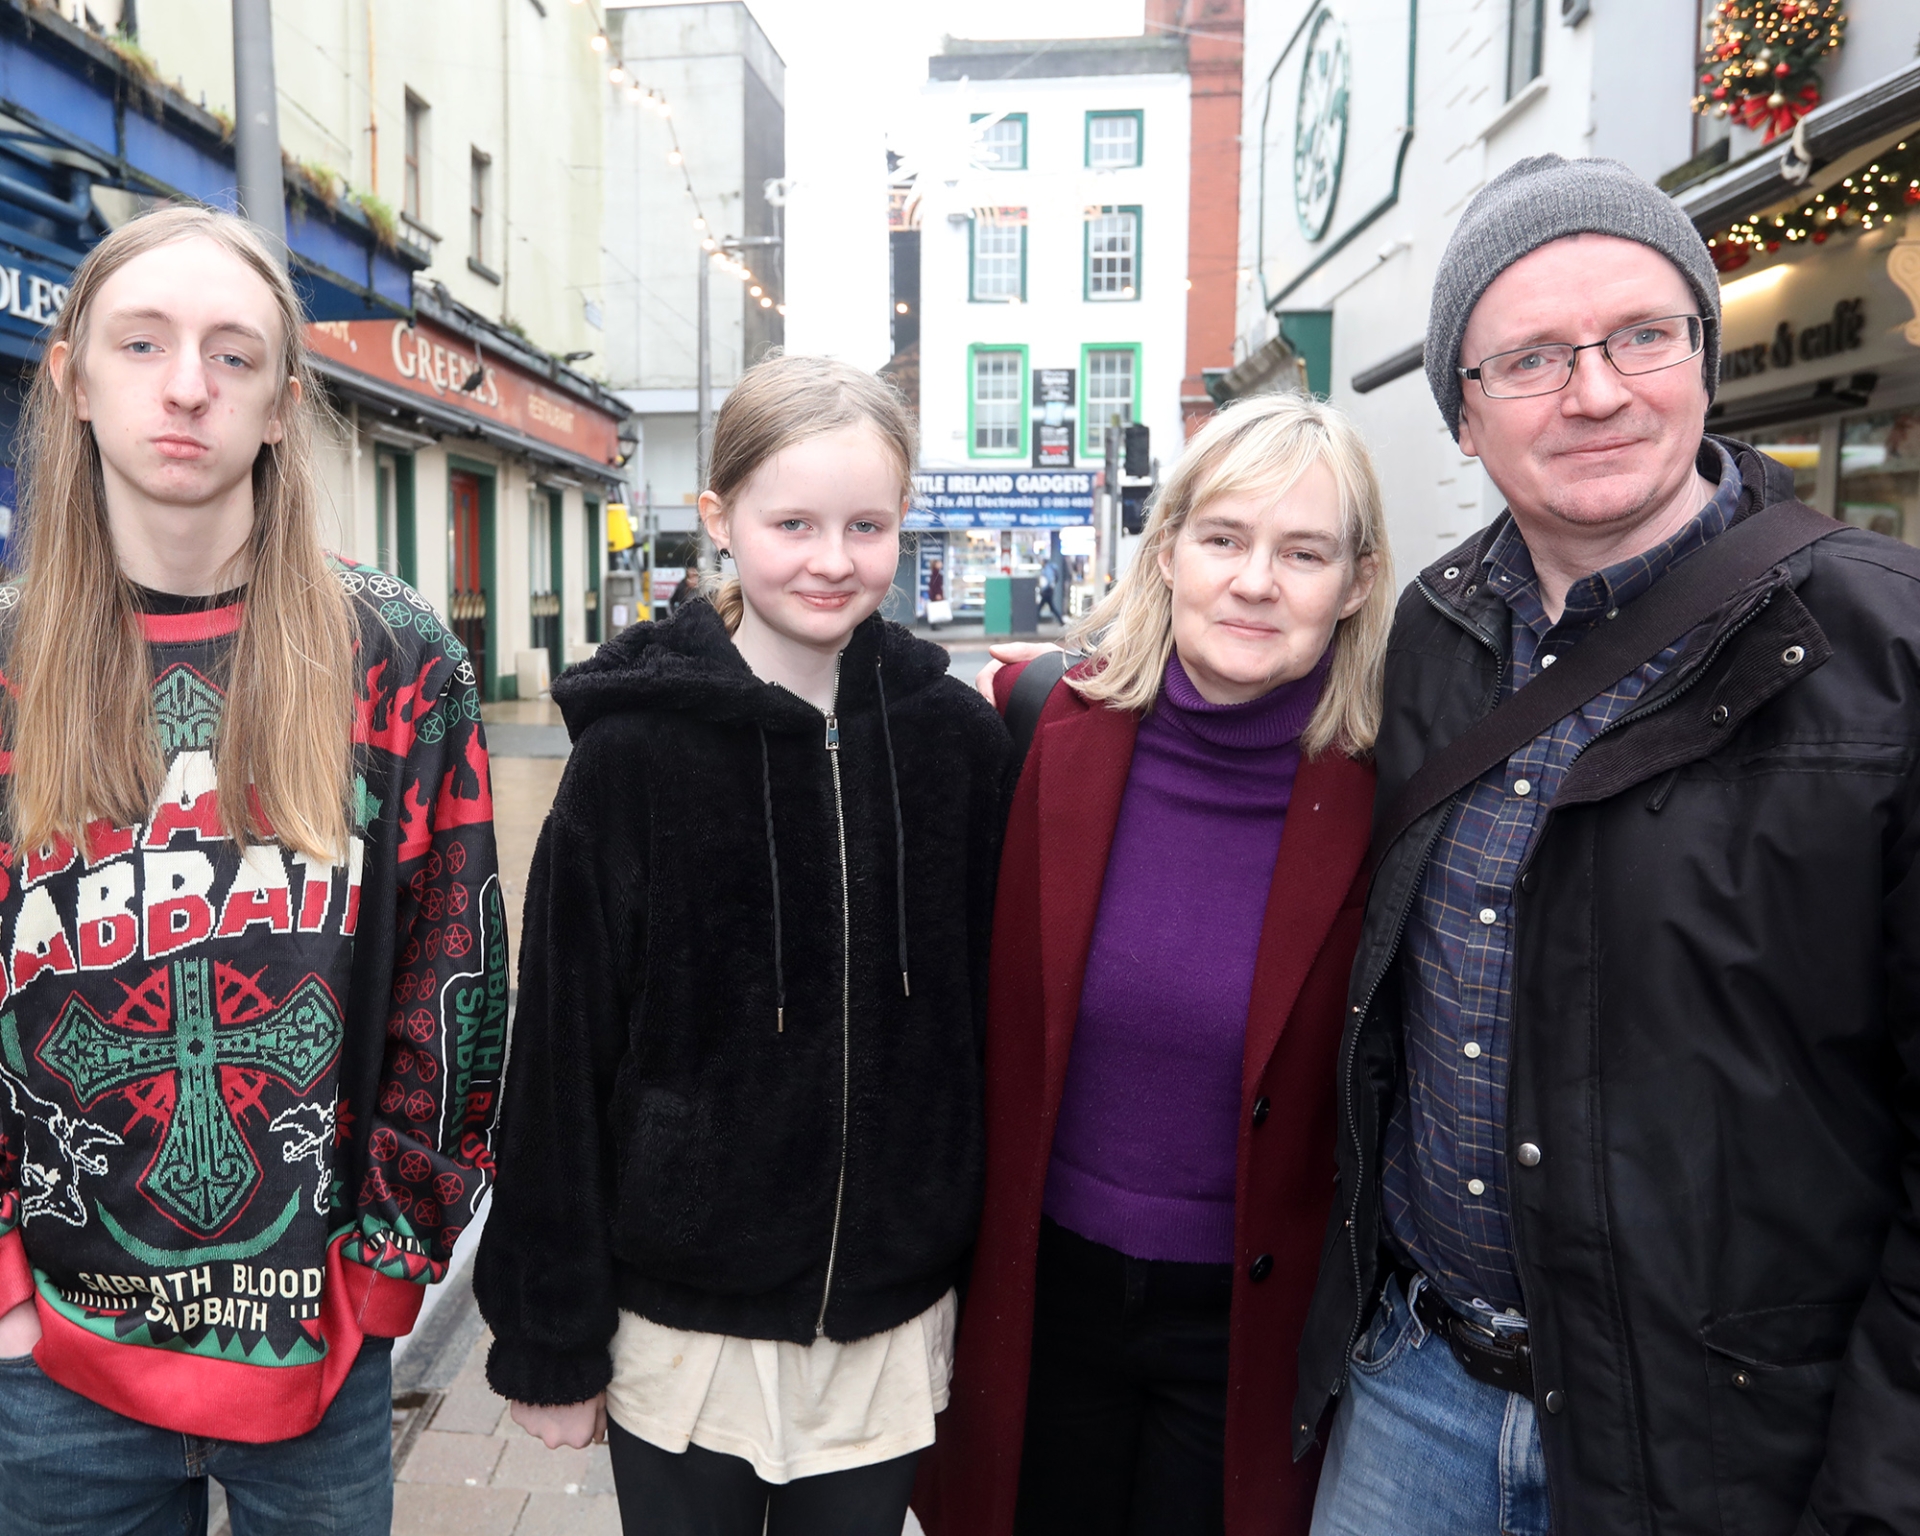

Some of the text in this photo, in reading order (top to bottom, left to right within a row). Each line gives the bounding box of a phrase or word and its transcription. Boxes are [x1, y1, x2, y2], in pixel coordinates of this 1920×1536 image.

[935, 496, 953, 508] Fix
[956, 496, 973, 508] All
[975, 495, 1039, 509] Electronics
[948, 475, 1013, 493] IRELAND
[1016, 475, 1090, 493] GADGETS
[0, 836, 364, 1003] ABBAT
[78, 1263, 326, 1303] SABBATH BLOOD
[145, 1294, 268, 1334] SABBATH
